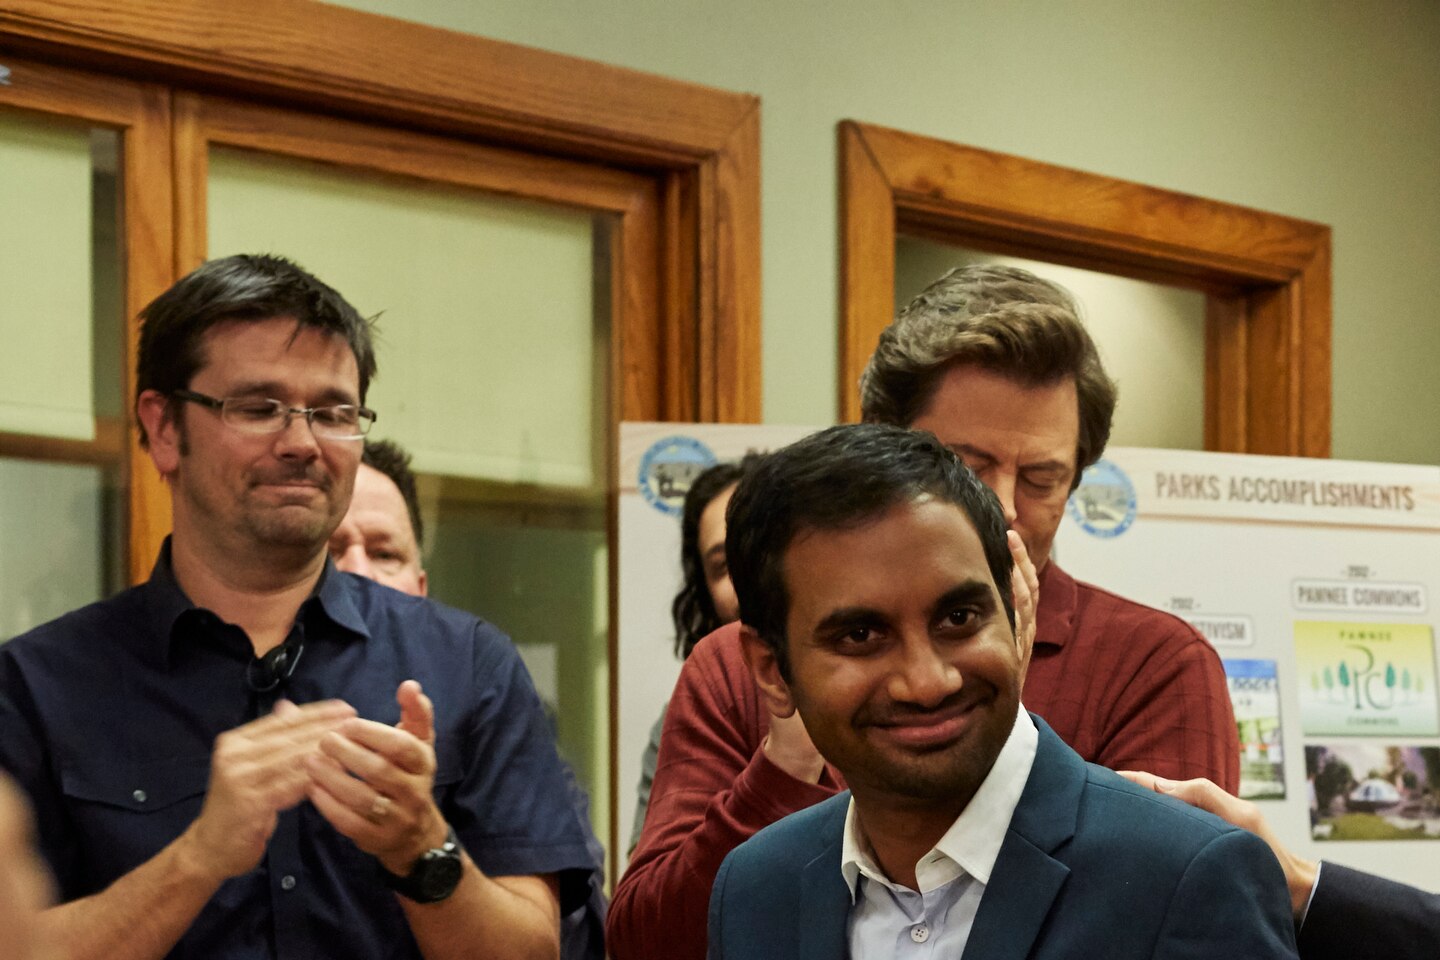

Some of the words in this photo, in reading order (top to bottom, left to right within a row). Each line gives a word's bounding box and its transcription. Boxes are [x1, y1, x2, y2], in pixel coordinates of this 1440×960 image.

[1155, 472, 1220, 500] PARKS
[1228, 477, 1414, 511] ACCOMPLISHMENTS
[1299, 586, 1348, 606] PAWNEE
[1354, 588, 1421, 608] COMMONS
